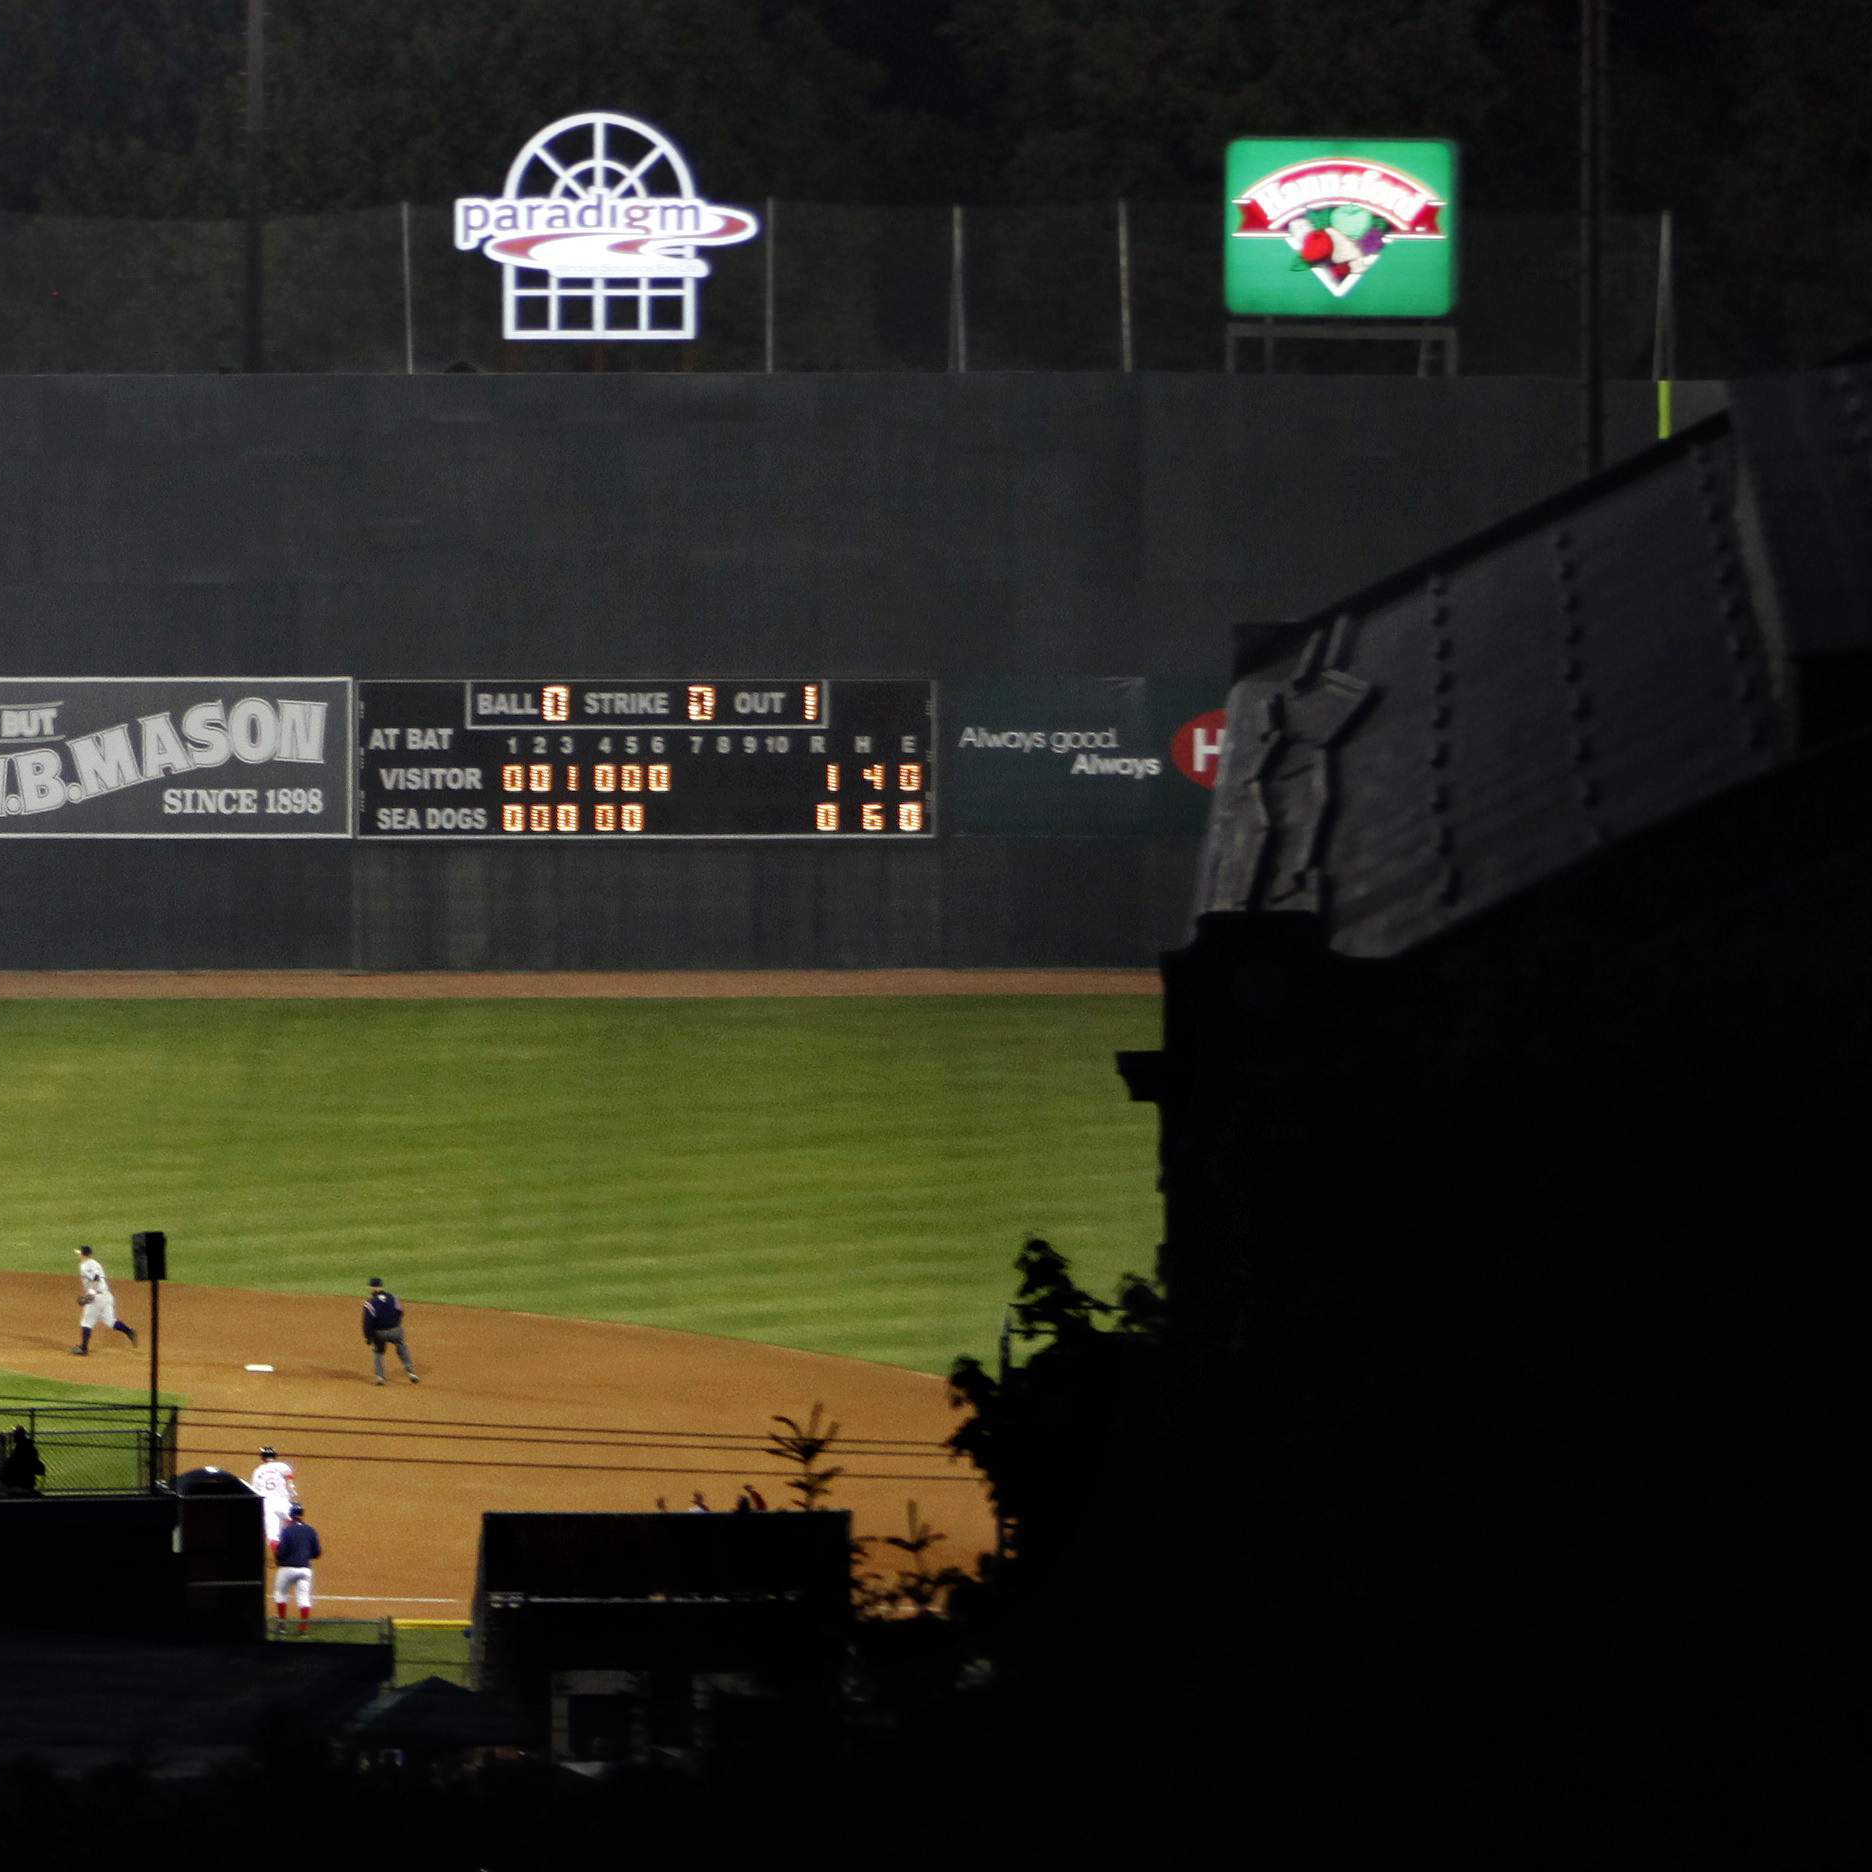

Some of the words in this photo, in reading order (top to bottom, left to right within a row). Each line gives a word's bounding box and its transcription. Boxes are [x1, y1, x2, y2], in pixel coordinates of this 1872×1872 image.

[462, 195, 701, 244] paradigm
[477, 693, 539, 715] BALL
[542, 685, 570, 721] 0
[584, 692, 670, 714] STRIKE
[734, 692, 786, 714] OUT
[804, 685, 819, 721] 1
[1, 708, 57, 738] BUT
[368, 728, 400, 750] AT
[406, 728, 454, 750] BAT
[507, 736, 518, 754] 1
[533, 736, 548, 754] 2
[559, 736, 575, 754] 3
[598, 736, 612, 754] 4
[625, 736, 639, 754] 5
[650, 736, 665, 754] 6
[689, 736, 704, 754] 7
[717, 736, 731, 754] 8
[743, 736, 757, 754] 9
[764, 736, 790, 754] 10
[809, 735, 826, 754] R
[855, 735, 872, 753] H
[901, 735, 917, 753] E
[958, 727, 1047, 753] Always
[378, 768, 484, 790] VISITOR
[1070, 754, 1163, 779] Always
[162, 788, 257, 815] SINCE
[265, 788, 324, 815] 1898
[376, 808, 421, 829] SEA
[425, 808, 488, 830] DOGS
